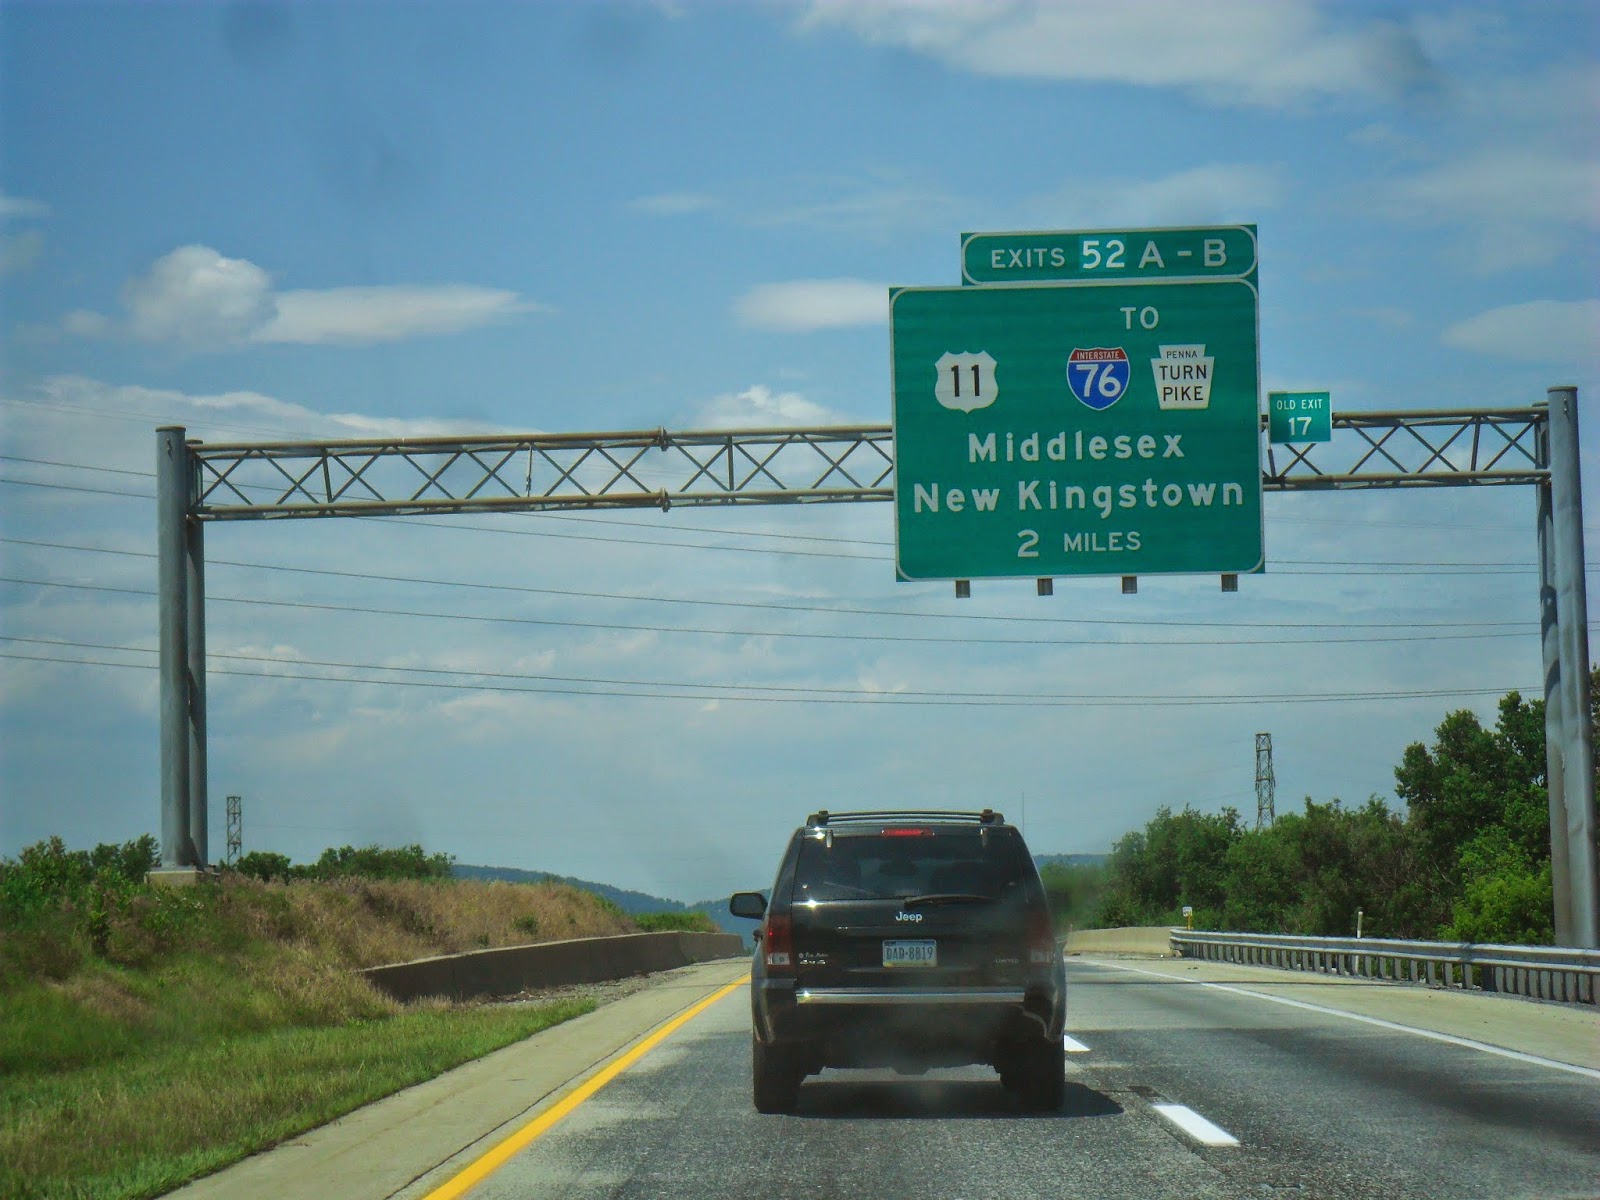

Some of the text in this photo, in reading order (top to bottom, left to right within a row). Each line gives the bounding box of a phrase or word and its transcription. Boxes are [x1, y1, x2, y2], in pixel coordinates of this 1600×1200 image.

[991, 248, 1065, 269] EXITS
[1082, 240, 1125, 269] 52
[1120, 306, 1159, 330] TO
[1077, 350, 1120, 360] INTERSTATE
[1166, 350, 1198, 359] PENNA
[951, 364, 981, 398] 11
[1076, 363, 1121, 397] 76
[1159, 364, 1208, 380] TURN
[1163, 386, 1204, 401] PIKE
[1276, 398, 1323, 410] OLD EXIT
[1288, 416, 1312, 436] 17
[968, 431, 1185, 463] Middlesex
[913, 477, 1244, 519] New Kingstown
[1017, 530, 1142, 558] 2 MILES
[895, 911, 923, 923] Jeep
